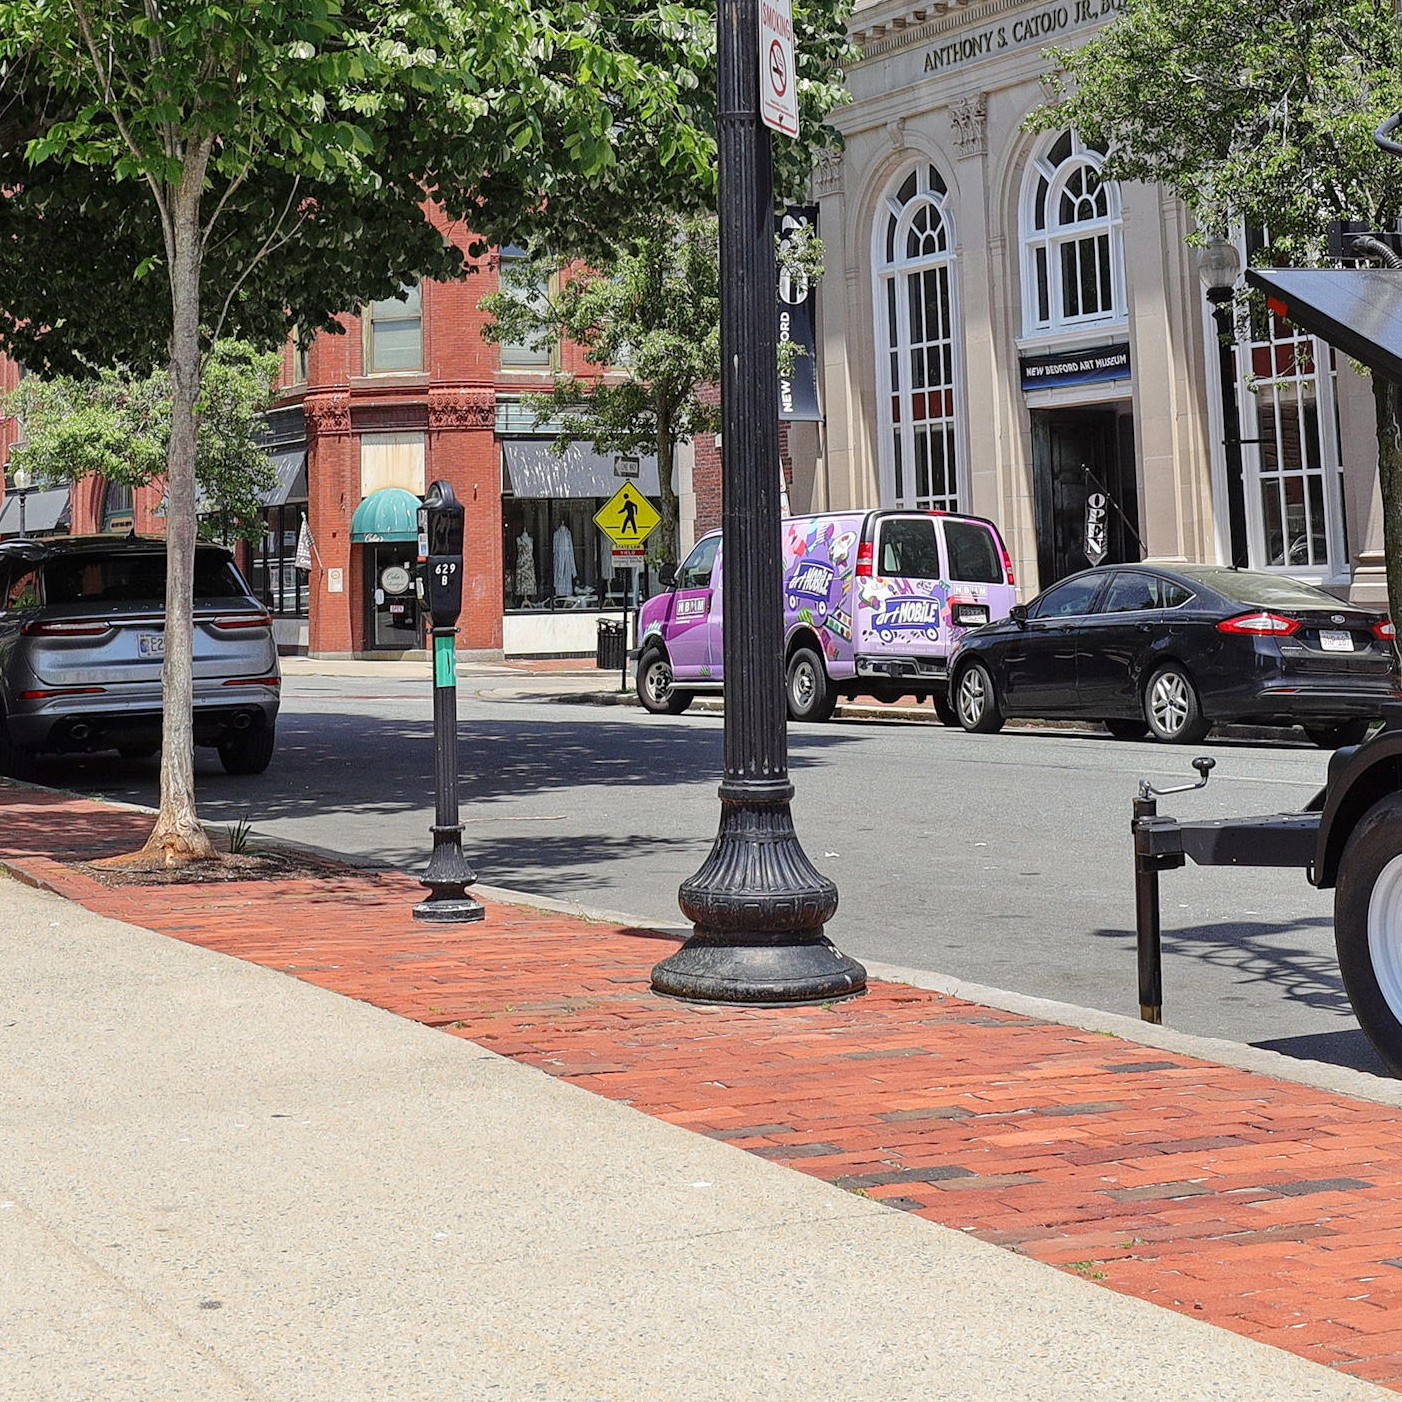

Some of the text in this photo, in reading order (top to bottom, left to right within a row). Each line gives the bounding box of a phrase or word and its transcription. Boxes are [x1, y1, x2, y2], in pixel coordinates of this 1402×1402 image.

[762, 1, 791, 41] SMOKING
[923, 30, 994, 73] ANTHONY
[997, 26, 1008, 48] S.
[1012, 7, 1068, 43] CATOJO
[1026, 354, 1127, 377] NEW BEDFORD ART MUSEUM
[780, 379, 794, 413] NEW
[1087, 492, 1106, 554] OPEN
[435, 563, 456, 575] 629
[441, 575, 448, 586] B
